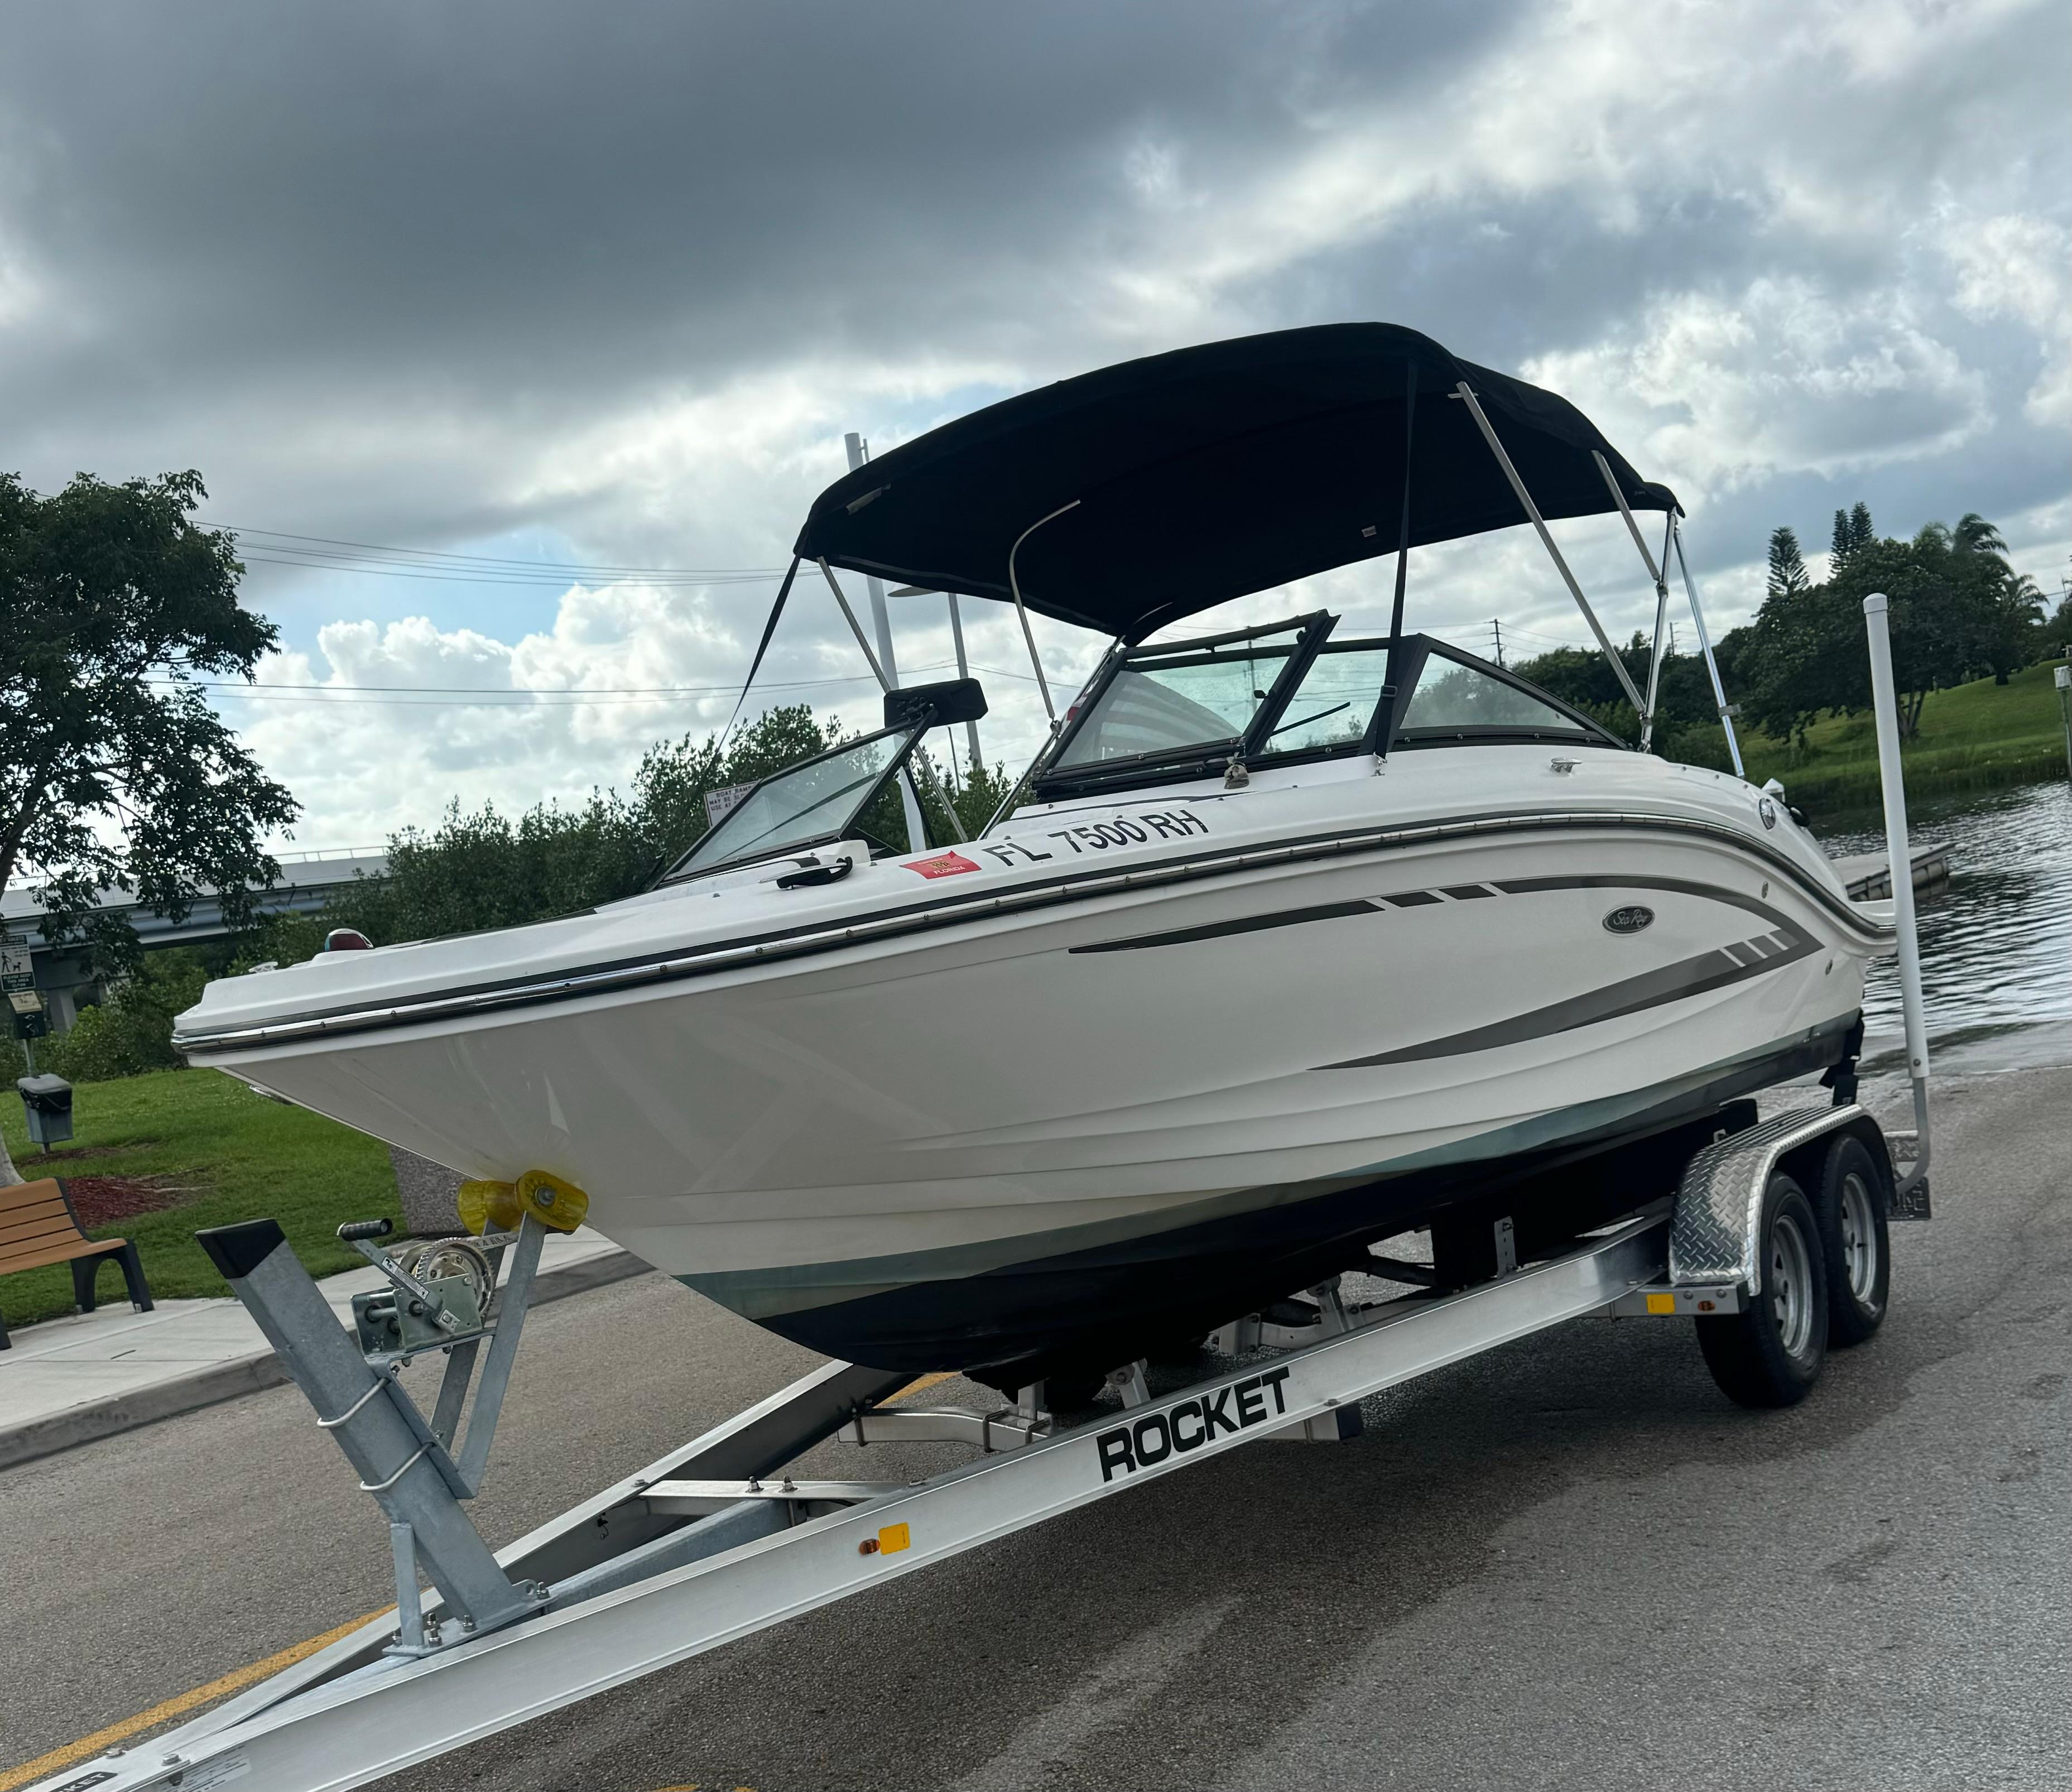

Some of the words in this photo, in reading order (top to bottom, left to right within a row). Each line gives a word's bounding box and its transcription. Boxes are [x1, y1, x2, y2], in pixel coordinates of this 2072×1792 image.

[982, 843, 1053, 866] FL
[1047, 820, 1147, 853] 7500
[1139, 810, 1209, 838] RH
[934, 866, 966, 875] FLORIDA
[1097, 1366, 1290, 1483] ROCKET
